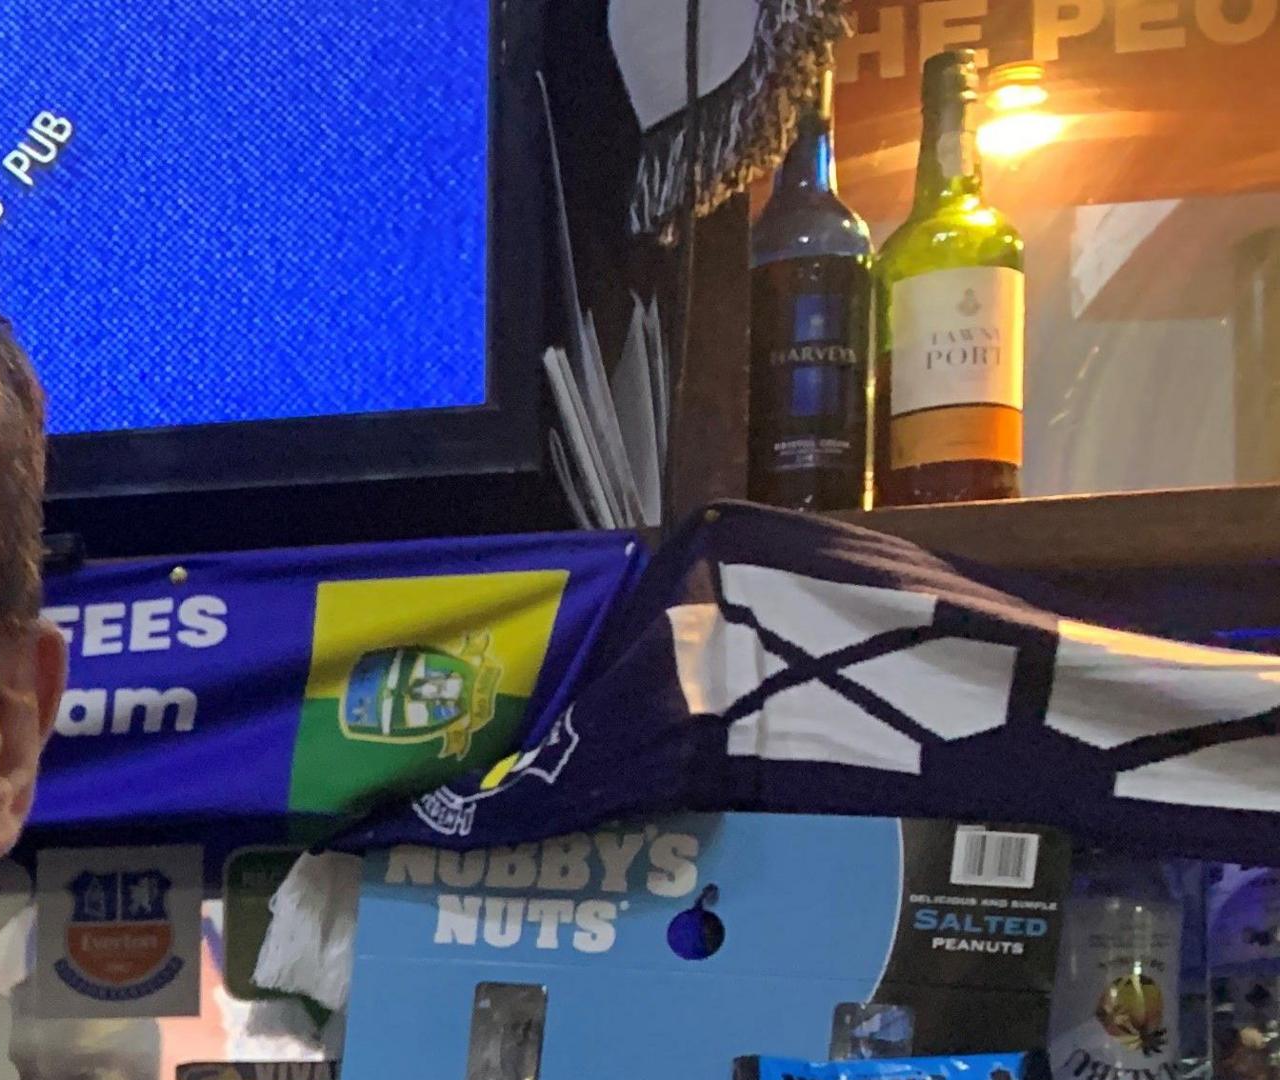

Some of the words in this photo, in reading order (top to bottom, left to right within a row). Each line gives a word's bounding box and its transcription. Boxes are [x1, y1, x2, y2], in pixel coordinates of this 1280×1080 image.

[2, 110, 73, 186] PUB
[433, 894, 618, 953] NUTS
[913, 907, 1049, 938] SALTED
[931, 936, 1025, 955] PEANUTS
